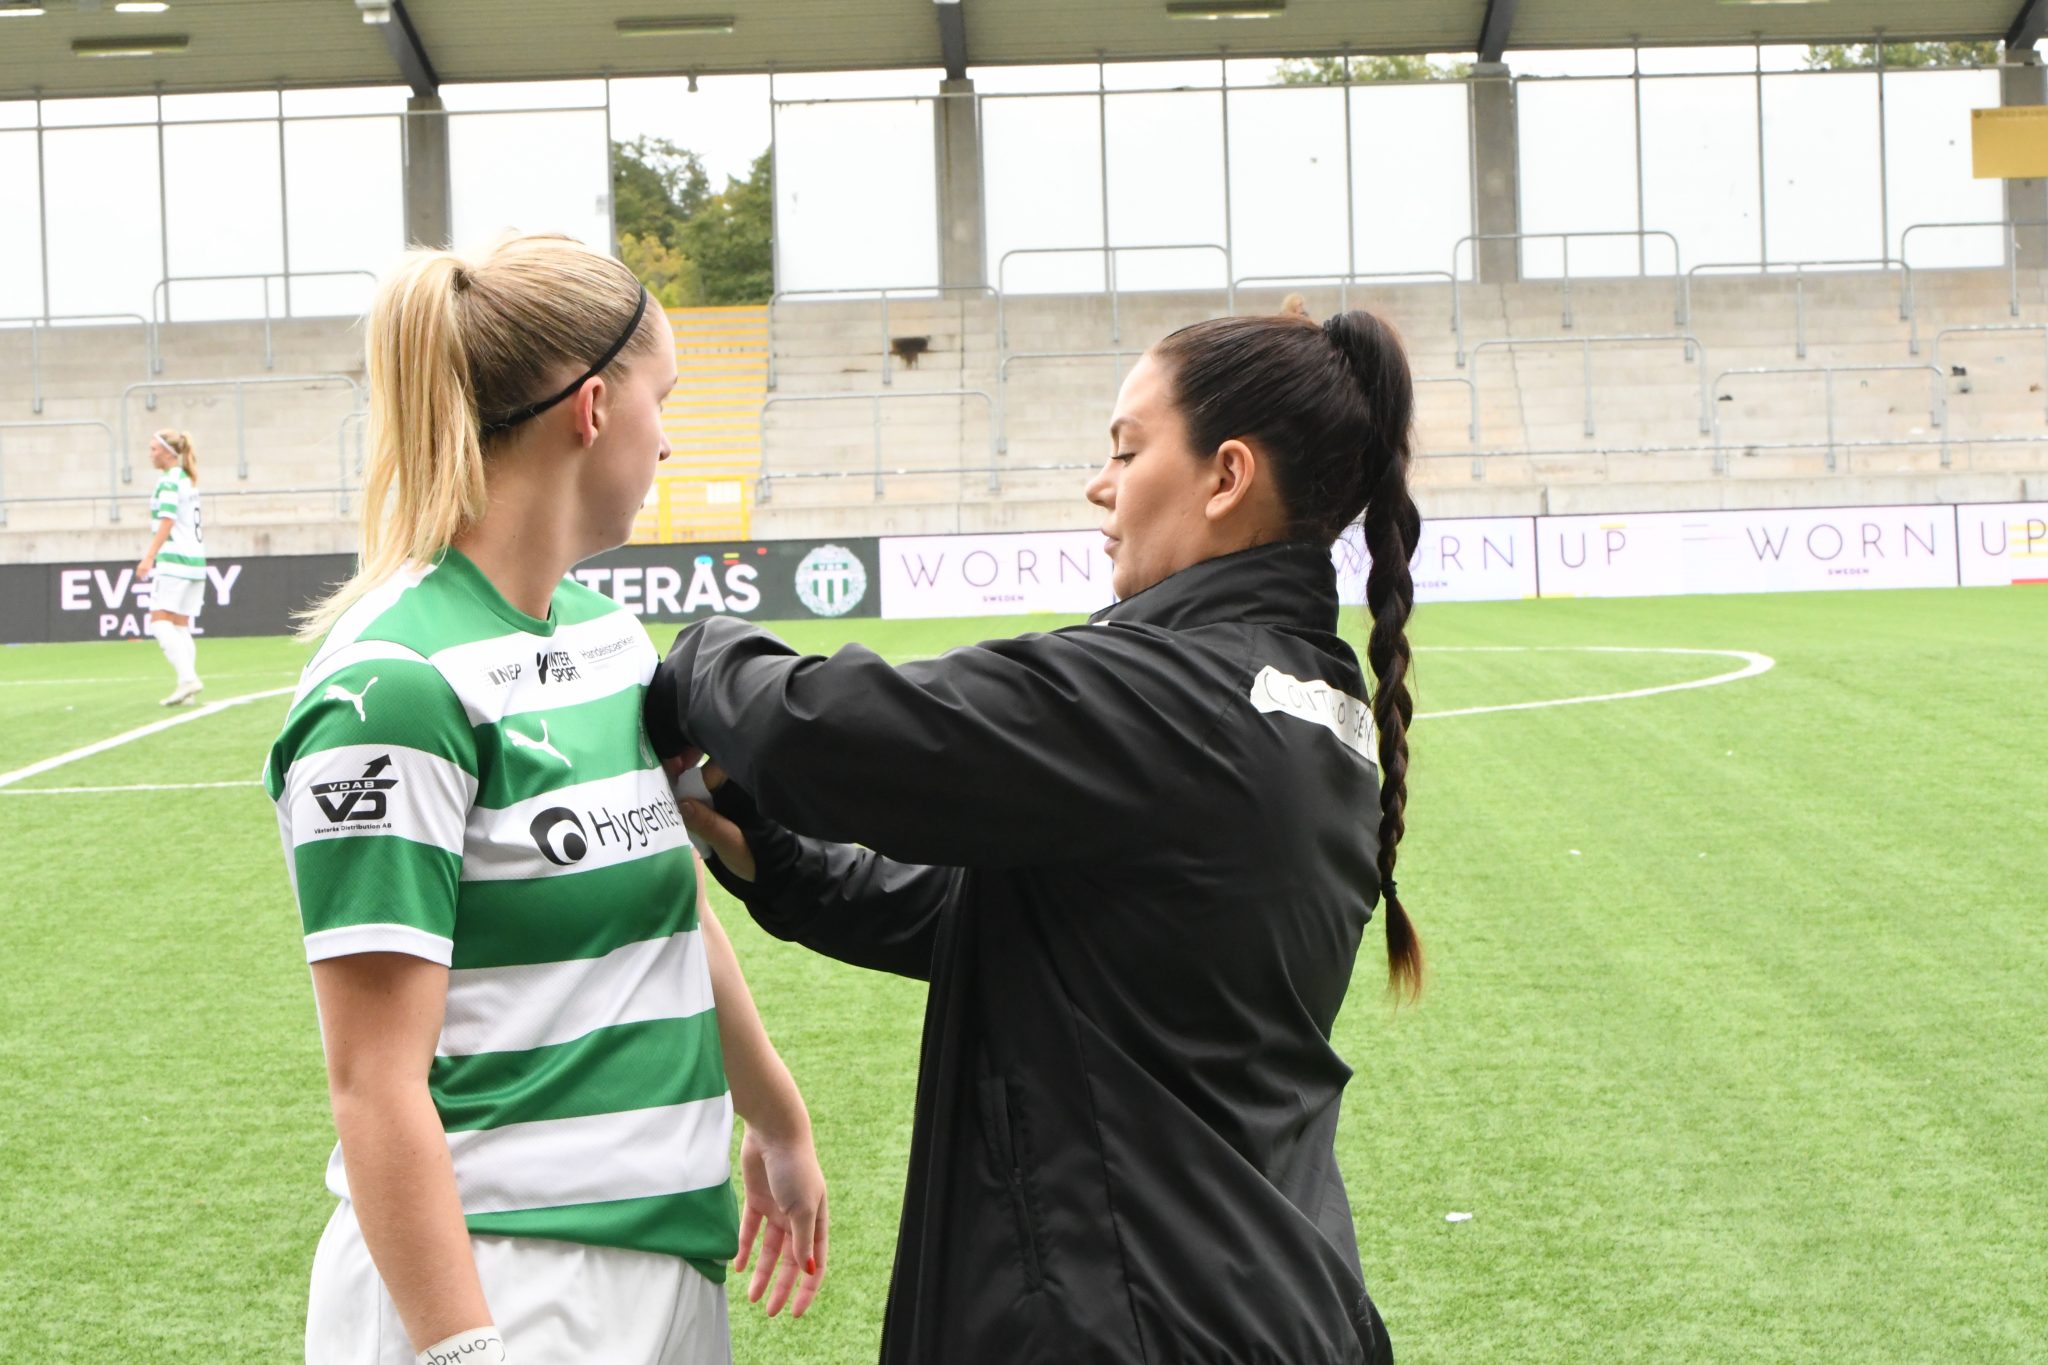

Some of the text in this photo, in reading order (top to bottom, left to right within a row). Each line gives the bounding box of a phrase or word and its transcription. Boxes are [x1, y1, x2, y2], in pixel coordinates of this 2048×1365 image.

[1746, 518, 2047, 561] WORN UP
[1334, 530, 1627, 574] WRN UP
[901, 548, 1091, 588] WORN
[565, 554, 761, 614] TERÅS
[982, 595, 1024, 603] SWEDEN
[99, 614, 204, 637] PAL
[548, 651, 574, 668] INTER
[551, 666, 582, 683] SPORT
[328, 781, 375, 791] VDAB
[340, 823, 381, 831] Distribution
